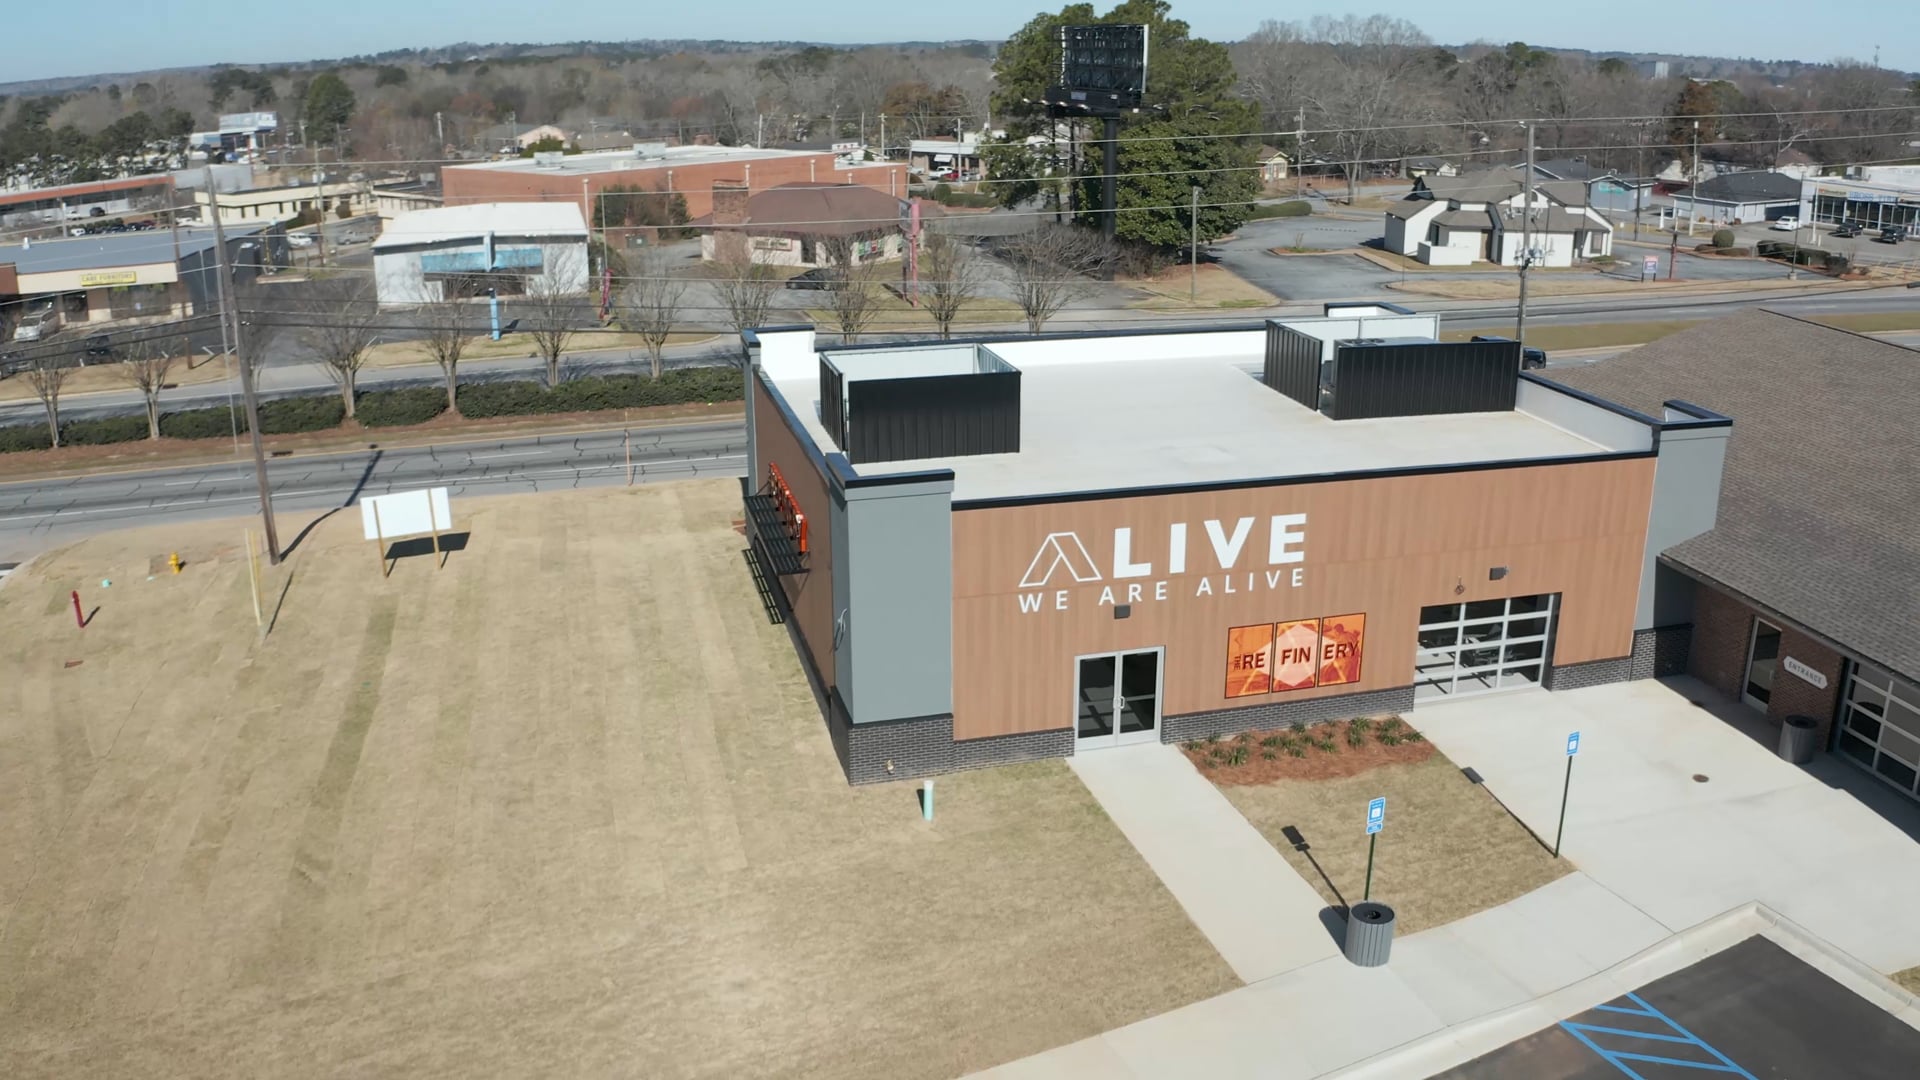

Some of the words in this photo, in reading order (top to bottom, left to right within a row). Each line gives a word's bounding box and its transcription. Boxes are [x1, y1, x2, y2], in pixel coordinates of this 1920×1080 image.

[1018, 590, 1068, 613] WE
[1099, 581, 1168, 606] ARE
[1196, 568, 1304, 597] ALIVE
[1788, 661, 1822, 684] ENTRANCE
